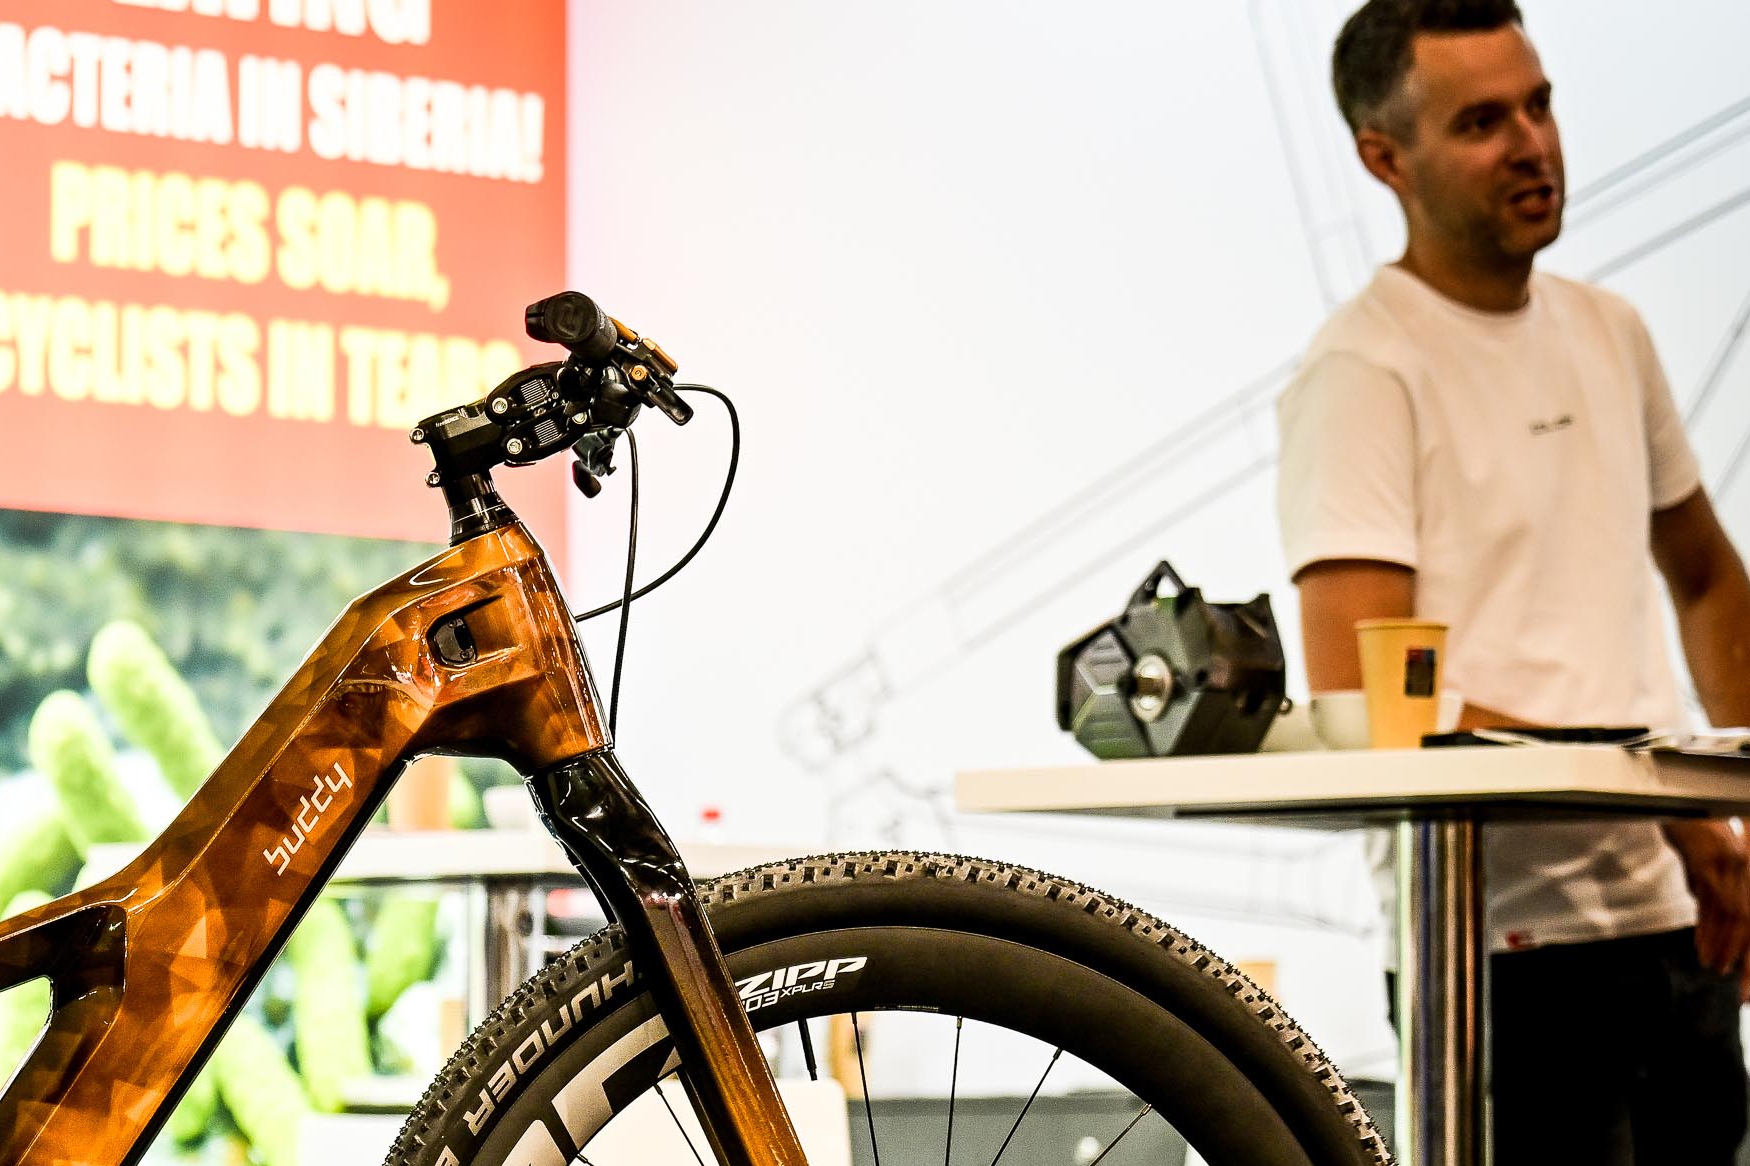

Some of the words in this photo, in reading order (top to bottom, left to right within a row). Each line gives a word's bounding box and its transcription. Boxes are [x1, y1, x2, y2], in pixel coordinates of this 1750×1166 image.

[239, 53, 303, 153] IN
[308, 63, 545, 183] SIBERIA!
[51, 160, 272, 284] PRICES
[277, 186, 451, 312] SOAR,
[268, 318, 337, 424] IN
[262, 762, 356, 876] buddy
[736, 956, 868, 1001] ZIPP
[463, 959, 634, 1136] HUNDER
